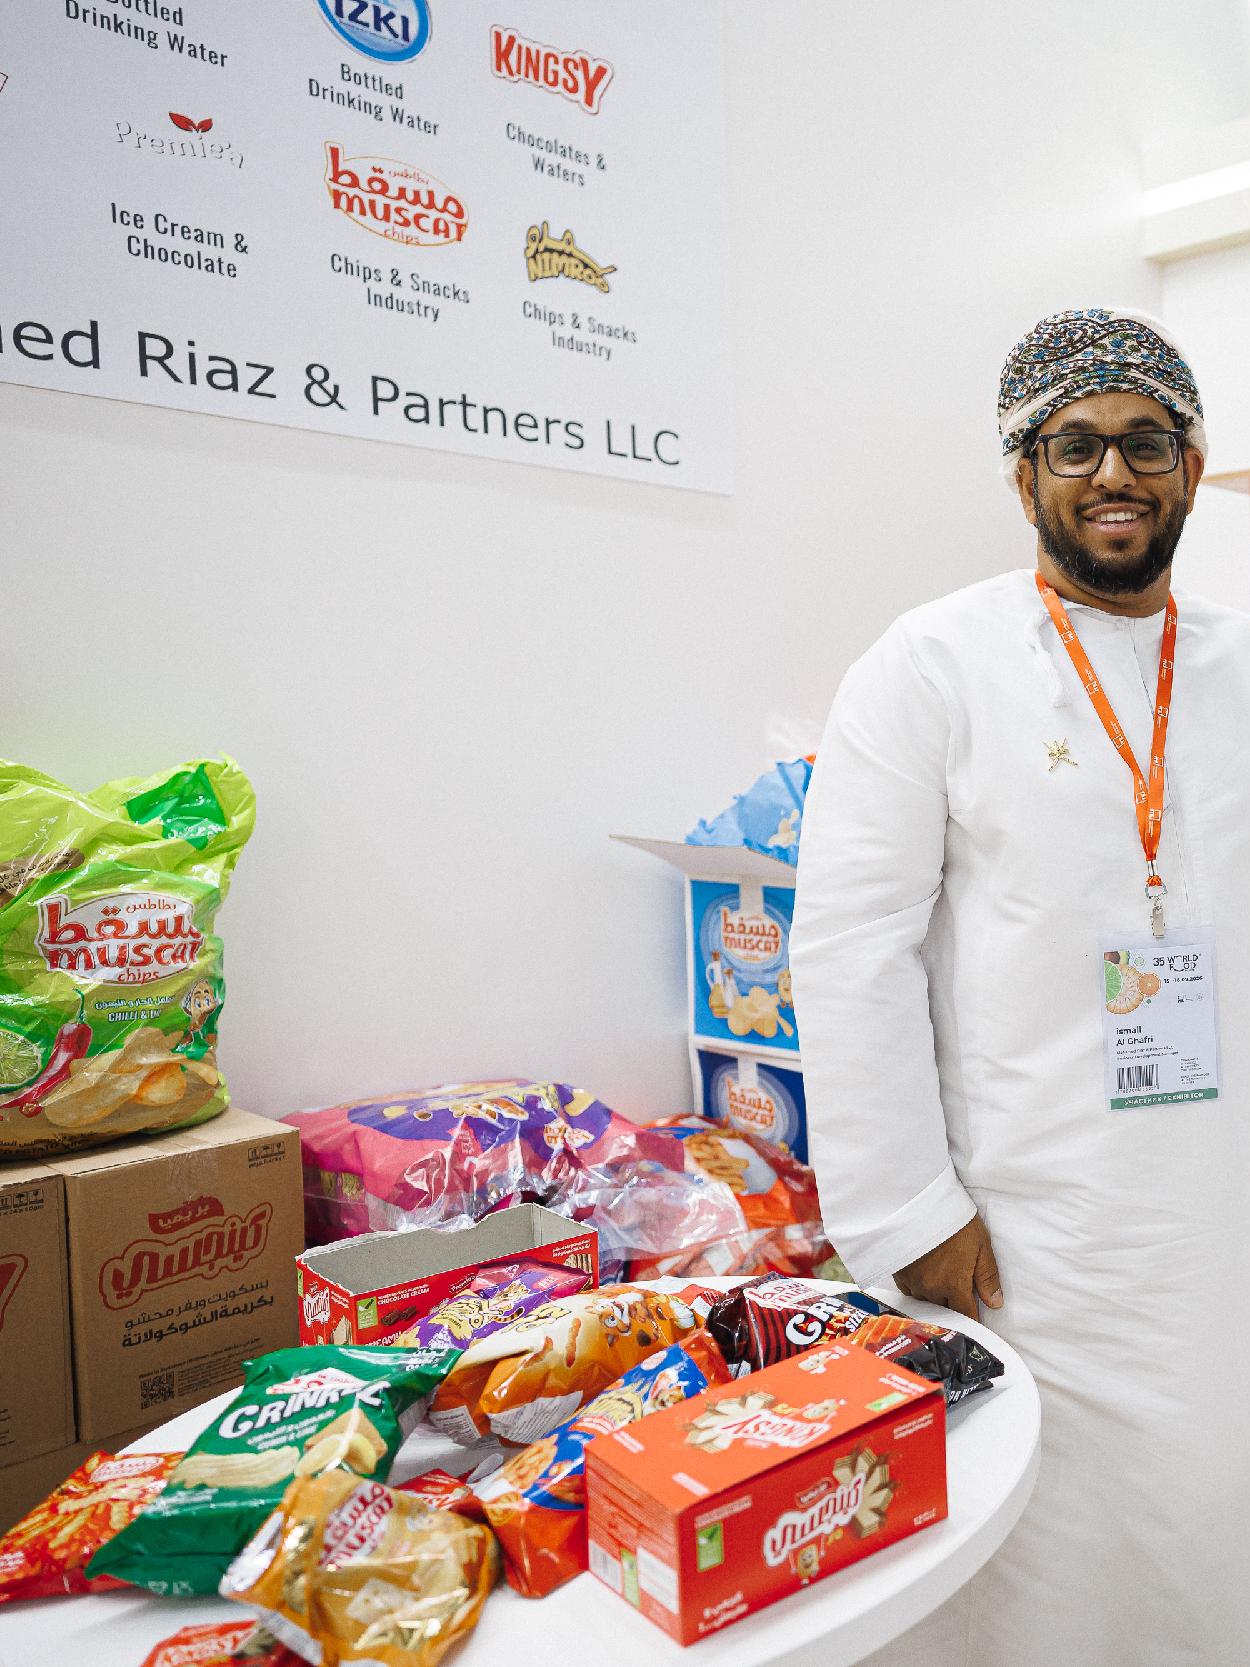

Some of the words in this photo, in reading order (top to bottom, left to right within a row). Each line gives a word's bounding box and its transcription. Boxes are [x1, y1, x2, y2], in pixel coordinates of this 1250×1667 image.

[65, 0, 159, 49] Drinking
[167, 31, 228, 67] Water
[104, 0, 184, 27] ottled
[335, 0, 410, 43] IZKI
[340, 63, 404, 100] Bottled
[494, 30, 608, 108] KINGSY
[308, 78, 383, 122] Drinking
[390, 104, 440, 136] Water
[506, 122, 591, 166] Chocolates
[596, 153, 607, 171] &
[329, 146, 465, 220] مسقط
[532, 154, 585, 187] Wafers
[111, 202, 145, 229] Ice
[154, 213, 224, 249] Cream
[234, 233, 248, 255] &
[383, 226, 421, 246] chips
[127, 235, 237, 278] Chocolate
[331, 253, 382, 283] Chips
[390, 268, 402, 287] &
[410, 273, 470, 304] Snacks
[367, 288, 440, 322] Industry
[522, 300, 564, 327] Chips
[571, 313, 580, 330] &
[587, 316, 638, 343] Snacks
[552, 331, 611, 361] Industry
[0, 319, 100, 370] ed
[137, 330, 277, 399] Riaz
[304, 363, 347, 411] &
[371, 375, 585, 450] Partners
[607, 419, 680, 466] LLC
[126, 899, 177, 914] بطاطس
[117, 968, 161, 984] chips
[1152, 957, 1165, 967] 35
[125, 1309, 176, 1330] محشو
